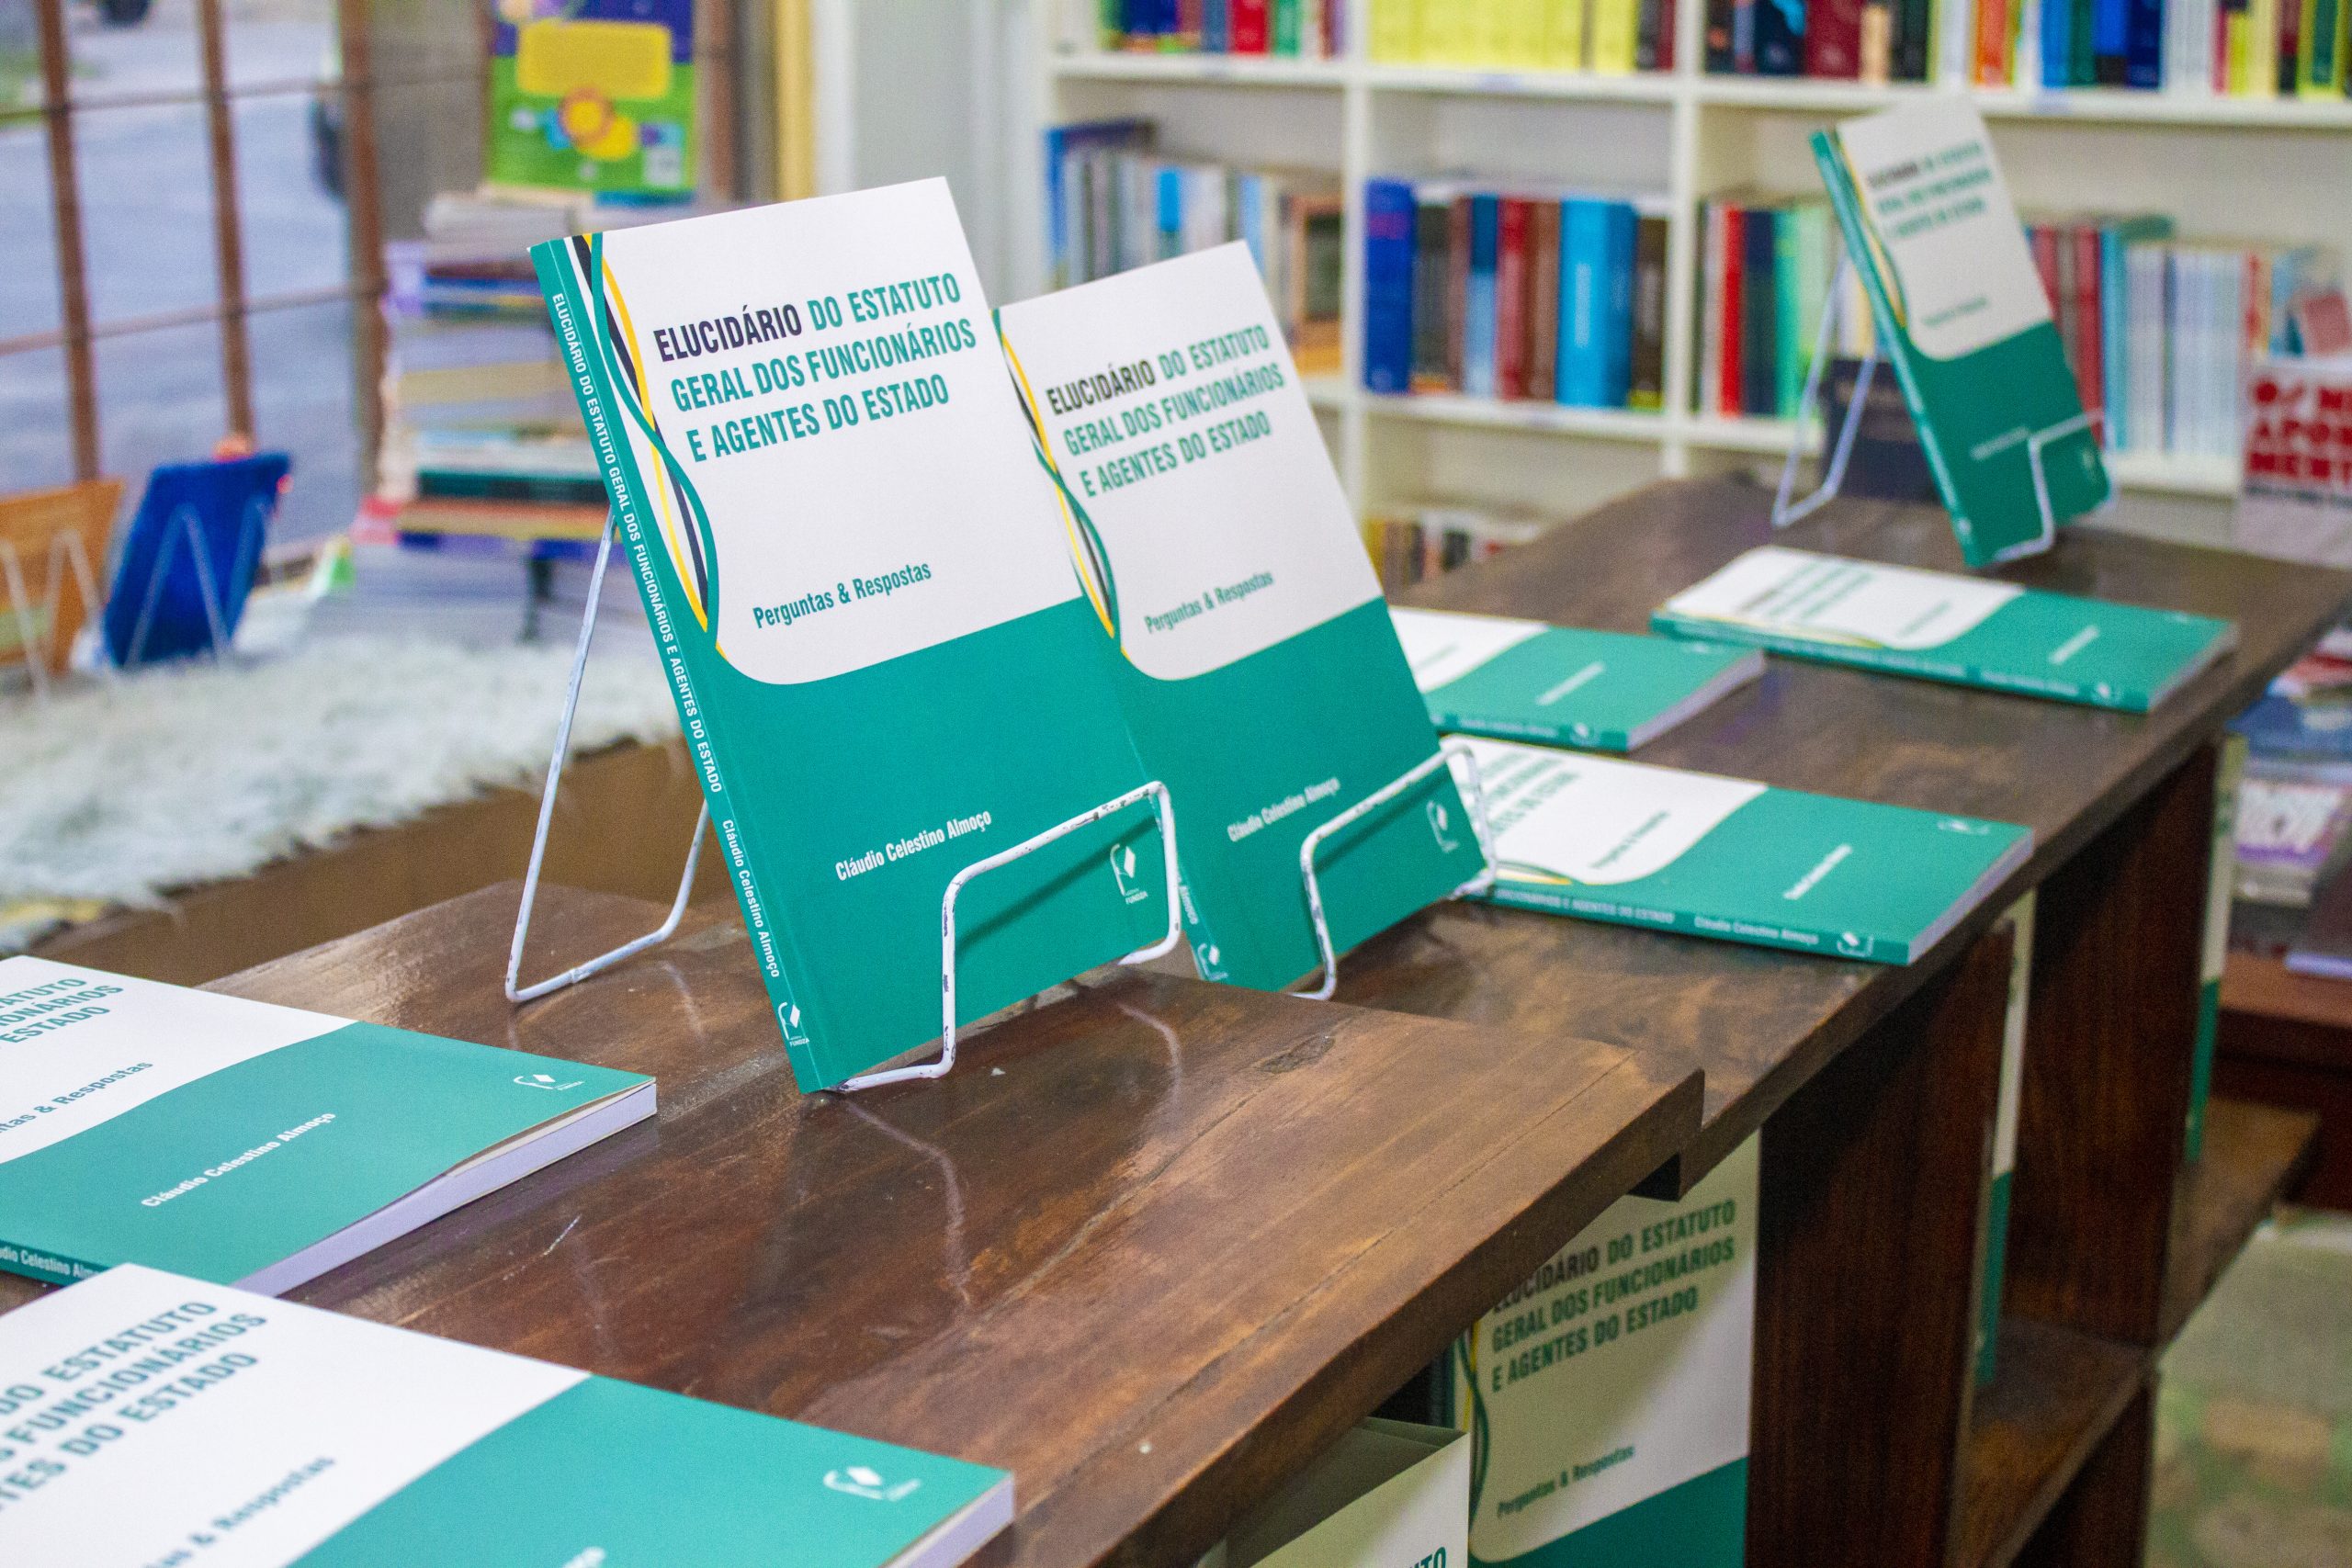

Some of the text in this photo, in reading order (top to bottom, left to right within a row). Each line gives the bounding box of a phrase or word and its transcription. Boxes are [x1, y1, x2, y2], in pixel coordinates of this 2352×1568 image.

[653, 272, 961, 362] ELUCIDÁRIO DO ESTATUTO
[671, 318, 977, 412] GERAL DOS FUNCIONÁRIOS
[1046, 324, 1271, 416] ELUCIDÁRIO DO ESTATUTO
[1063, 362, 1286, 457] GERAL DOS FUNCIONÁRIOS
[685, 374, 949, 462] E AGENTES DO ESTADO
[1079, 411, 1272, 498] E AGENTES DO ESTADO
[552, 292, 723, 794] ELUCIDÁRIO DO ESTATUTO GERAL DOS FUNCIONÁRIOS E AGENTES DO ESTADO
[752, 562, 933, 629] Perguntas & Respostas
[1144, 600, 1203, 635] Perguntas
[1214, 571, 1274, 604] Respostas
[835, 810, 992, 882] Cláudio Celestino Almoço
[722, 818, 780, 978] Cláudio Celestino Almoço
[0, 978, 87, 1009] ATUTO
[0, 1006, 111, 1043] ESTADO
[34, 1105, 58, 1114] &
[51, 1061, 153, 1105] Respostas
[141, 1111, 337, 1208] Cláudio Celestino Almoço
[1608, 1234, 1634, 1265] DO
[1641, 1198, 1736, 1254] ESTATUTO
[1491, 1236, 1736, 1354] GERAL DOS FUNCIONÁRIOS
[1491, 1286, 1699, 1393] E AGENTES DO ESTADO
[4, 1313, 267, 1445] FUNCIONÁRIOS
[41, 1301, 218, 1382] ESTATUTO
[58, 1422, 125, 1457] DO
[116, 1351, 258, 1423] ESTADO
